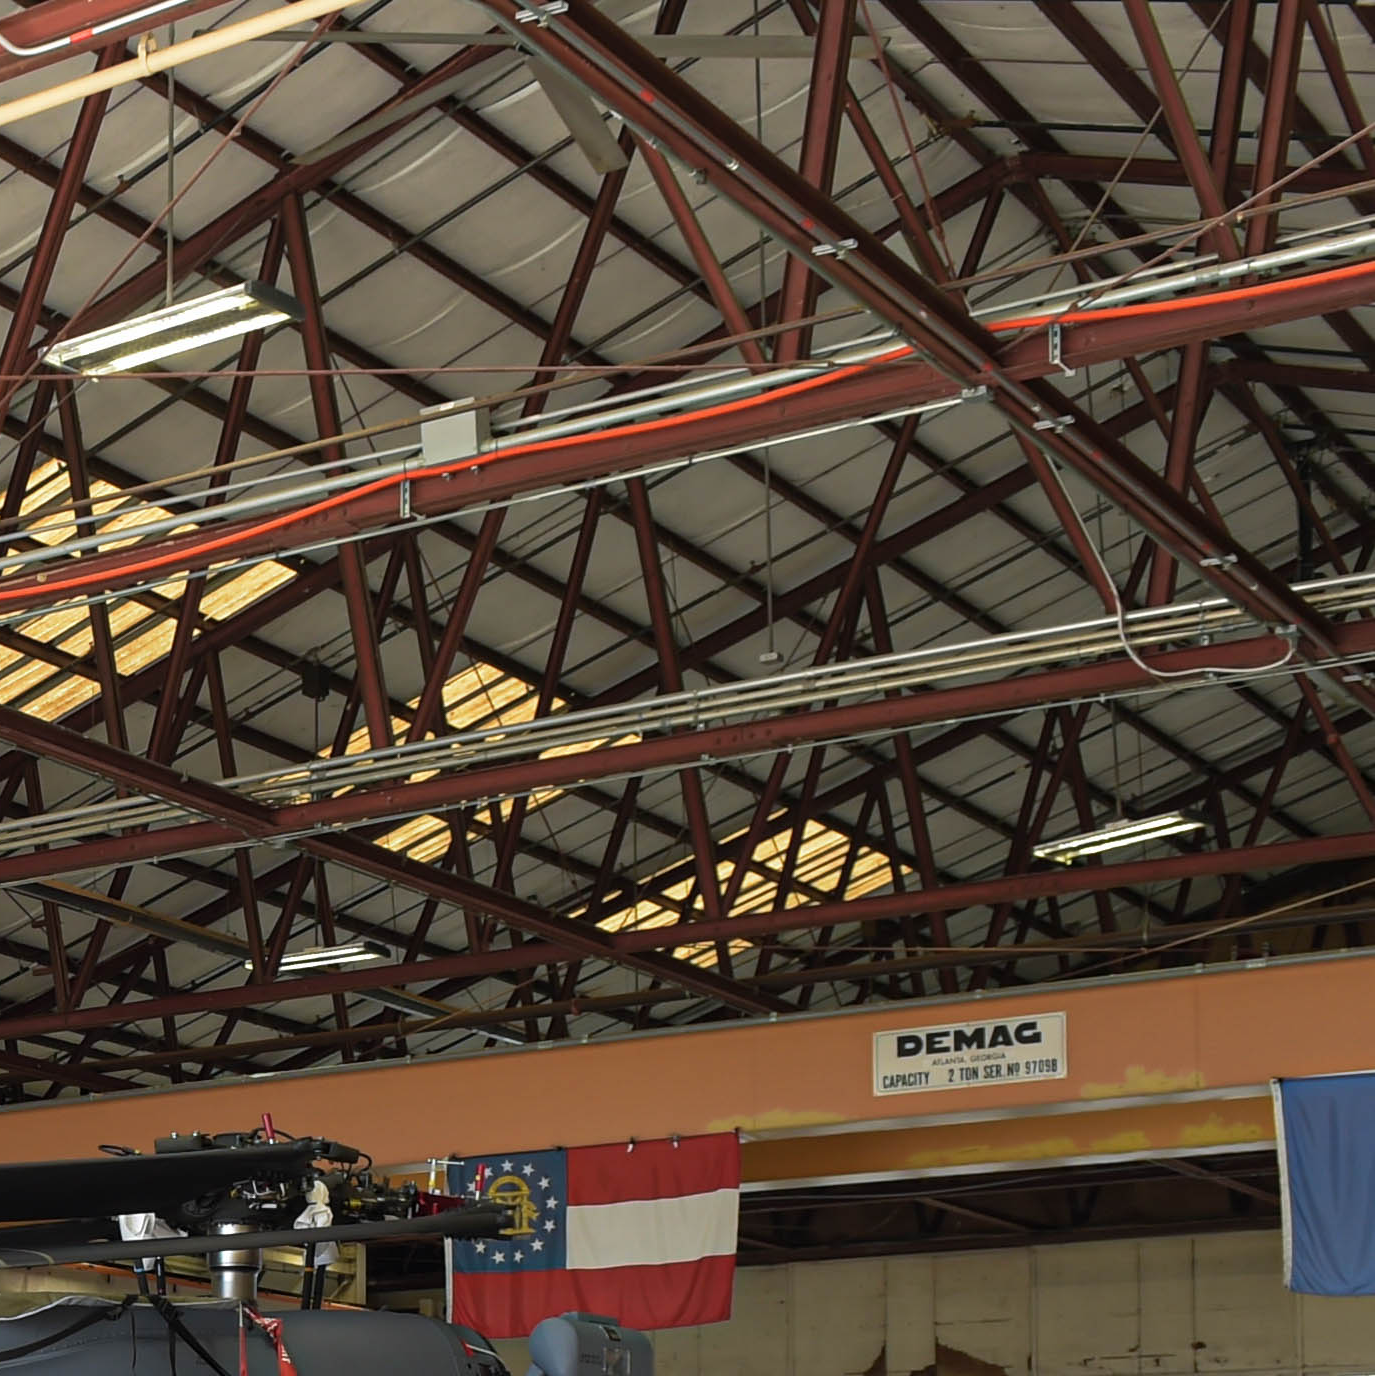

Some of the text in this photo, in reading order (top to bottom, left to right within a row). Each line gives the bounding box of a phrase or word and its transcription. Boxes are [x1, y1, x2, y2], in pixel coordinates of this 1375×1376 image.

[896, 1021, 1042, 1058] DEMAG
[970, 1052, 1007, 1063] GEORGIA
[883, 1071, 931, 1089] CAPACITY
[948, 1069, 955, 1083] 2
[960, 1066, 980, 1082] TON
